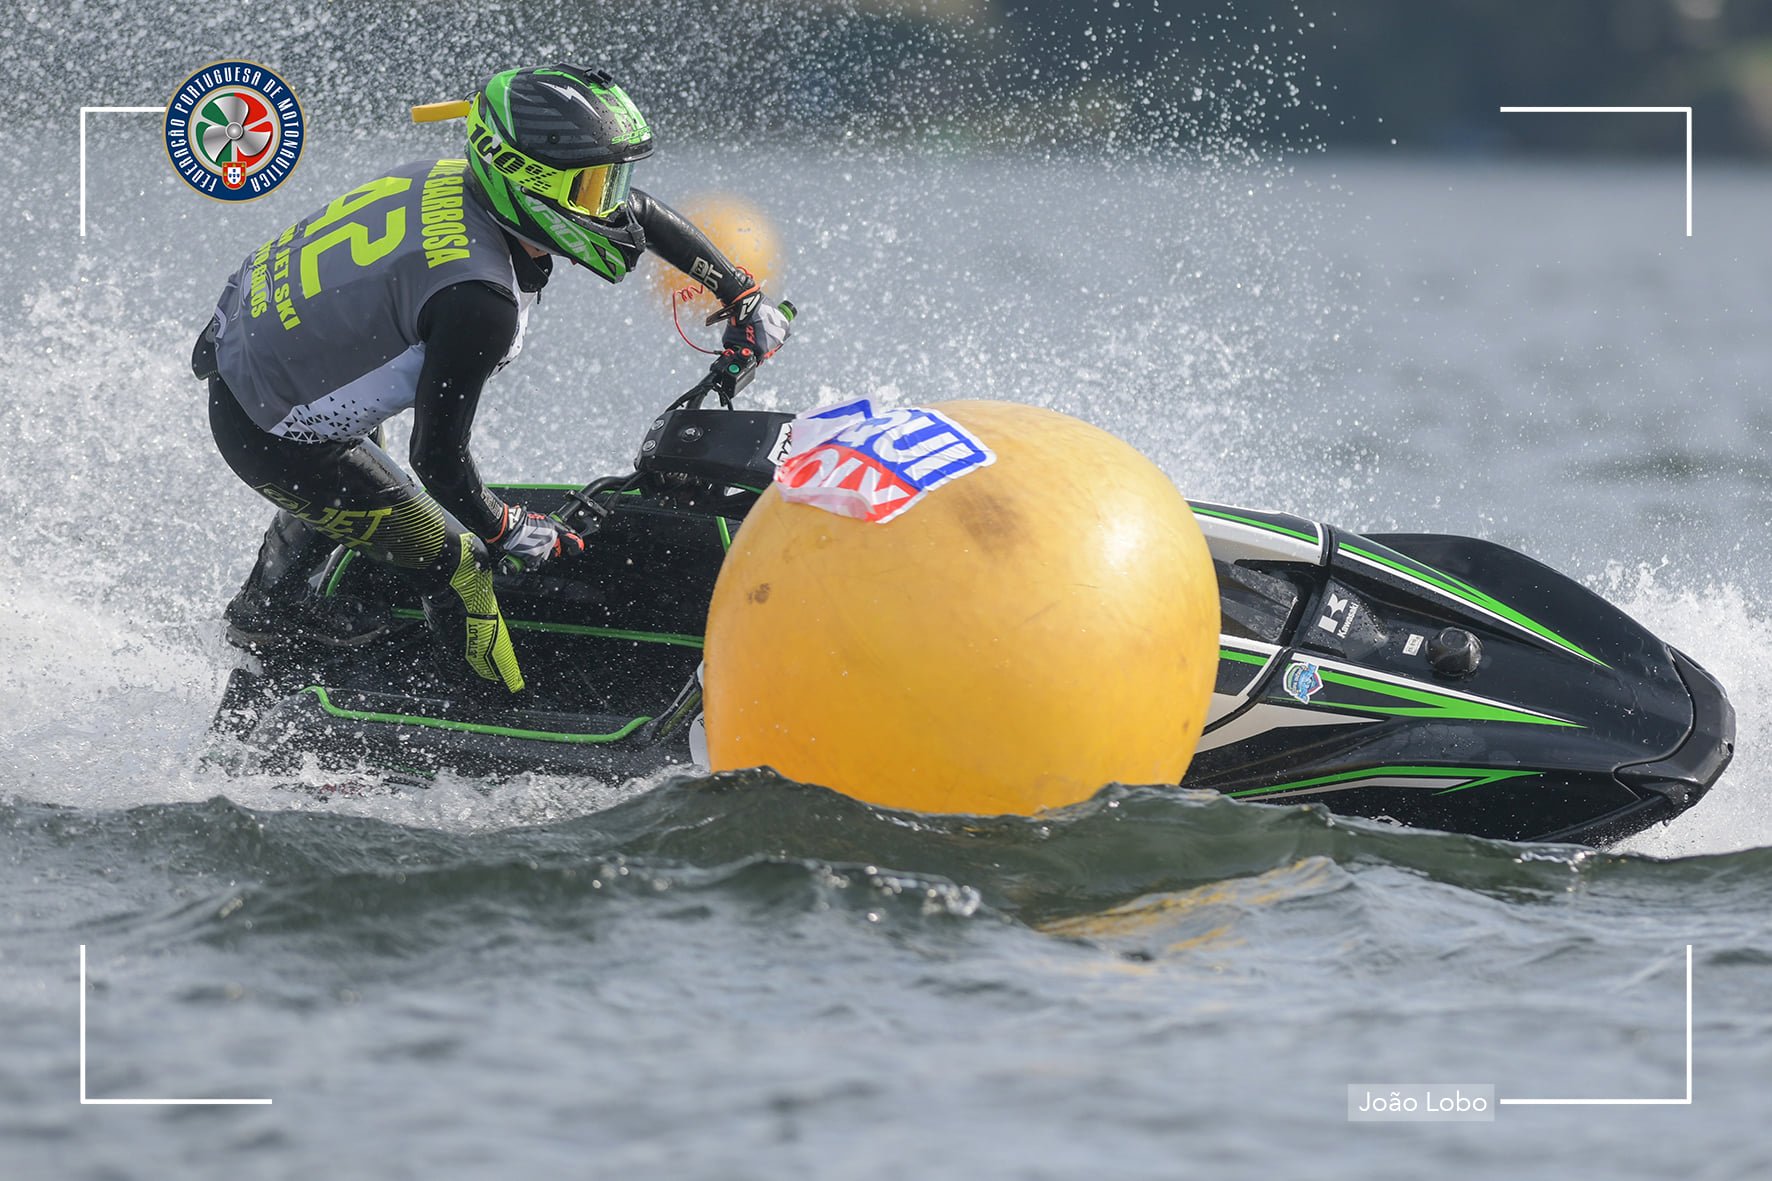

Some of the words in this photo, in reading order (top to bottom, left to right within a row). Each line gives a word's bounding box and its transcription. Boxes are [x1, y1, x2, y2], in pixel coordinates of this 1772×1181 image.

[300, 176, 413, 299] 42
[421, 175, 471, 269] BARBOSA
[274, 248, 291, 281] JET
[251, 264, 268, 318] GALOS
[274, 283, 302, 330] SKI
[296, 507, 393, 541] JET
[467, 624, 478, 659] JETPILOT
[1337, 602, 1358, 639] Kawasaki
